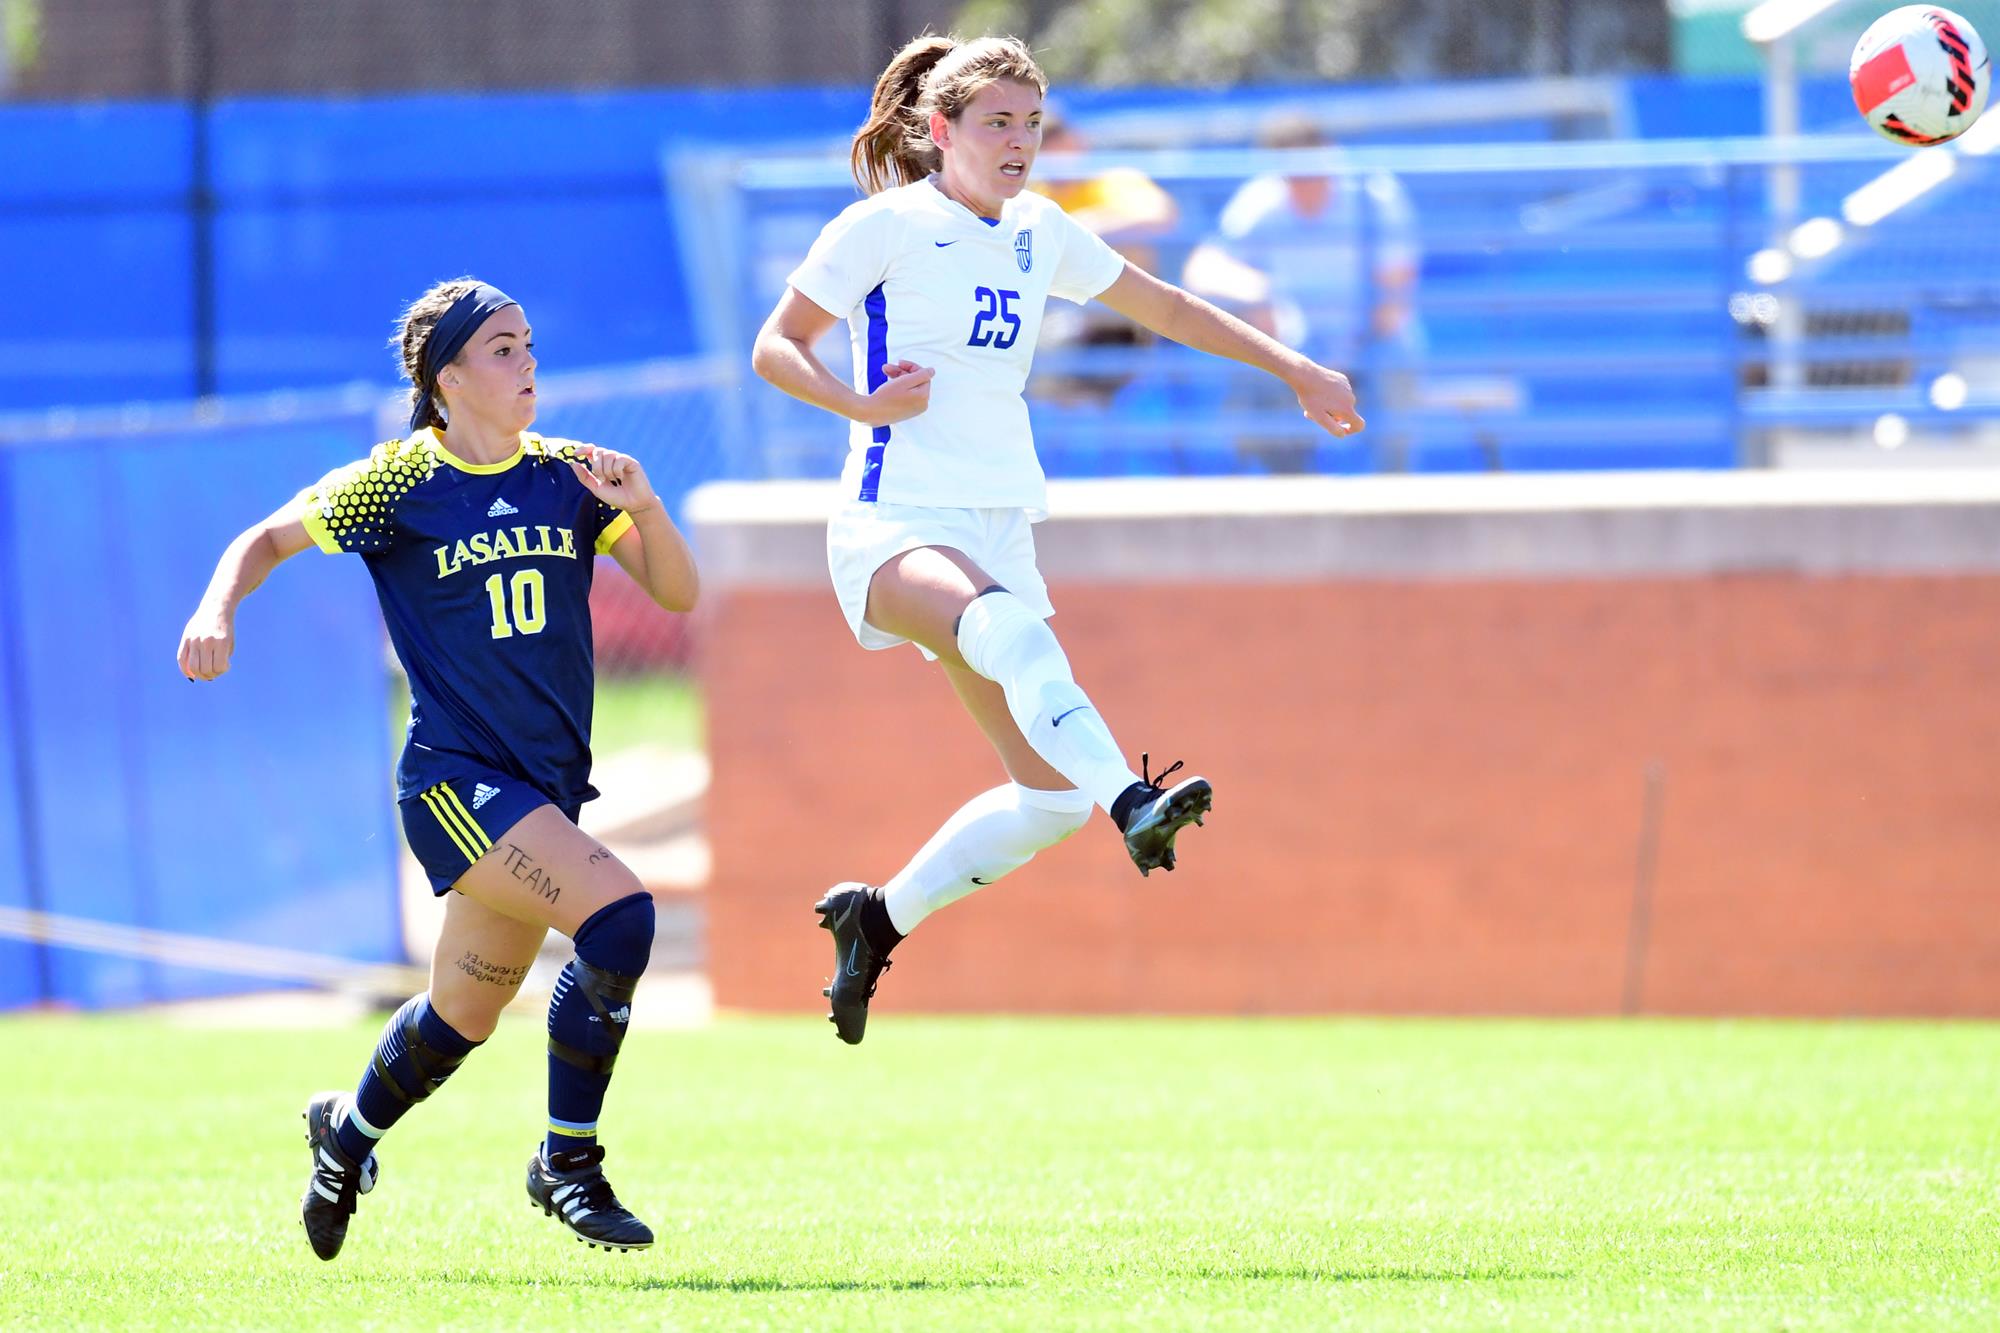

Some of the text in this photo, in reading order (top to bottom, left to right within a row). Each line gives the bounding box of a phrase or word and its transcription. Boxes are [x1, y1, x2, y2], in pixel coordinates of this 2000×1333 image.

[967, 286, 1021, 349] 25
[487, 507, 519, 517] adidas
[434, 526, 577, 579] LASALLE
[485, 568, 546, 639] 10
[472, 787, 501, 810] adidas
[504, 844, 561, 904] TEAM
[464, 951, 510, 975] FOREVER
